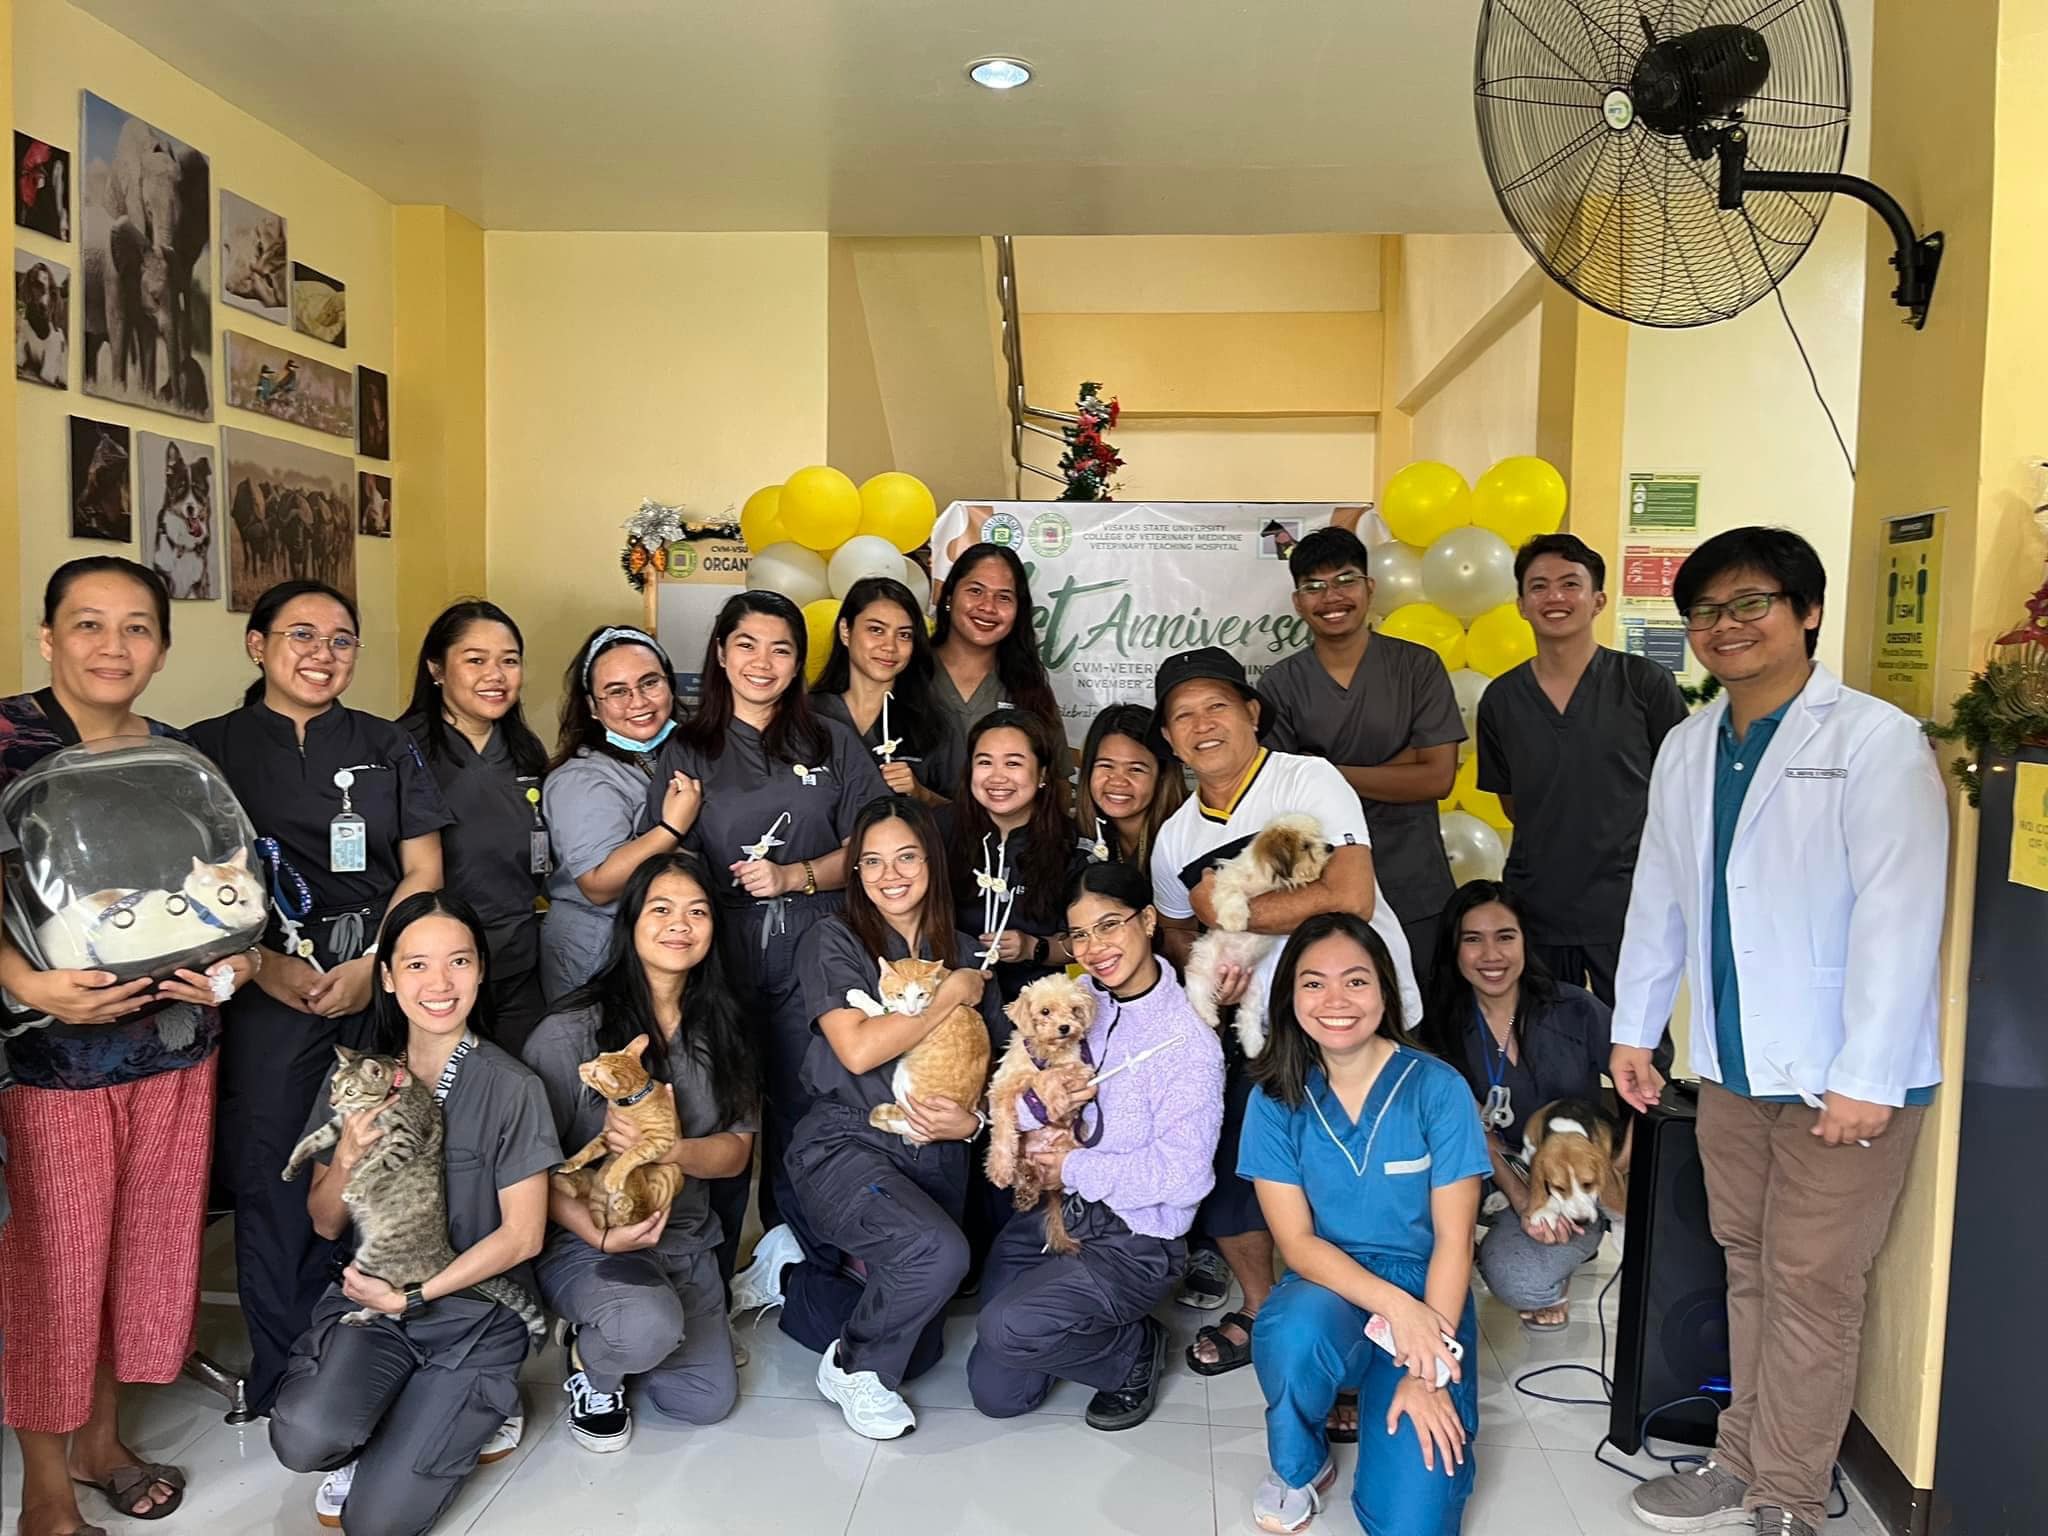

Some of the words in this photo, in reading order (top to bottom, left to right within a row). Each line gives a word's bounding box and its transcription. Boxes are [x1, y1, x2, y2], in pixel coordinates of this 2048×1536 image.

[1103, 524, 1140, 532] VISAYAS
[1143, 524, 1169, 532] STATE
[1172, 524, 1227, 533] UNIVERSITY
[1082, 533, 1122, 541] COLLEGE
[1124, 533, 1137, 541] OF
[1139, 533, 1195, 542] VETERINARY
[1197, 534, 1243, 542] MEDICINE
[1090, 542, 1146, 550] VETERINARY
[1149, 543, 1193, 551] TEACHING
[1195, 543, 1240, 552] HOSPITAL
[703, 556, 752, 572] ORGAN
[1078, 593, 1312, 658] Anniversa
[1072, 662, 1160, 674] CVM-VETERI
[1077, 678, 1142, 689] NOVEMBER
